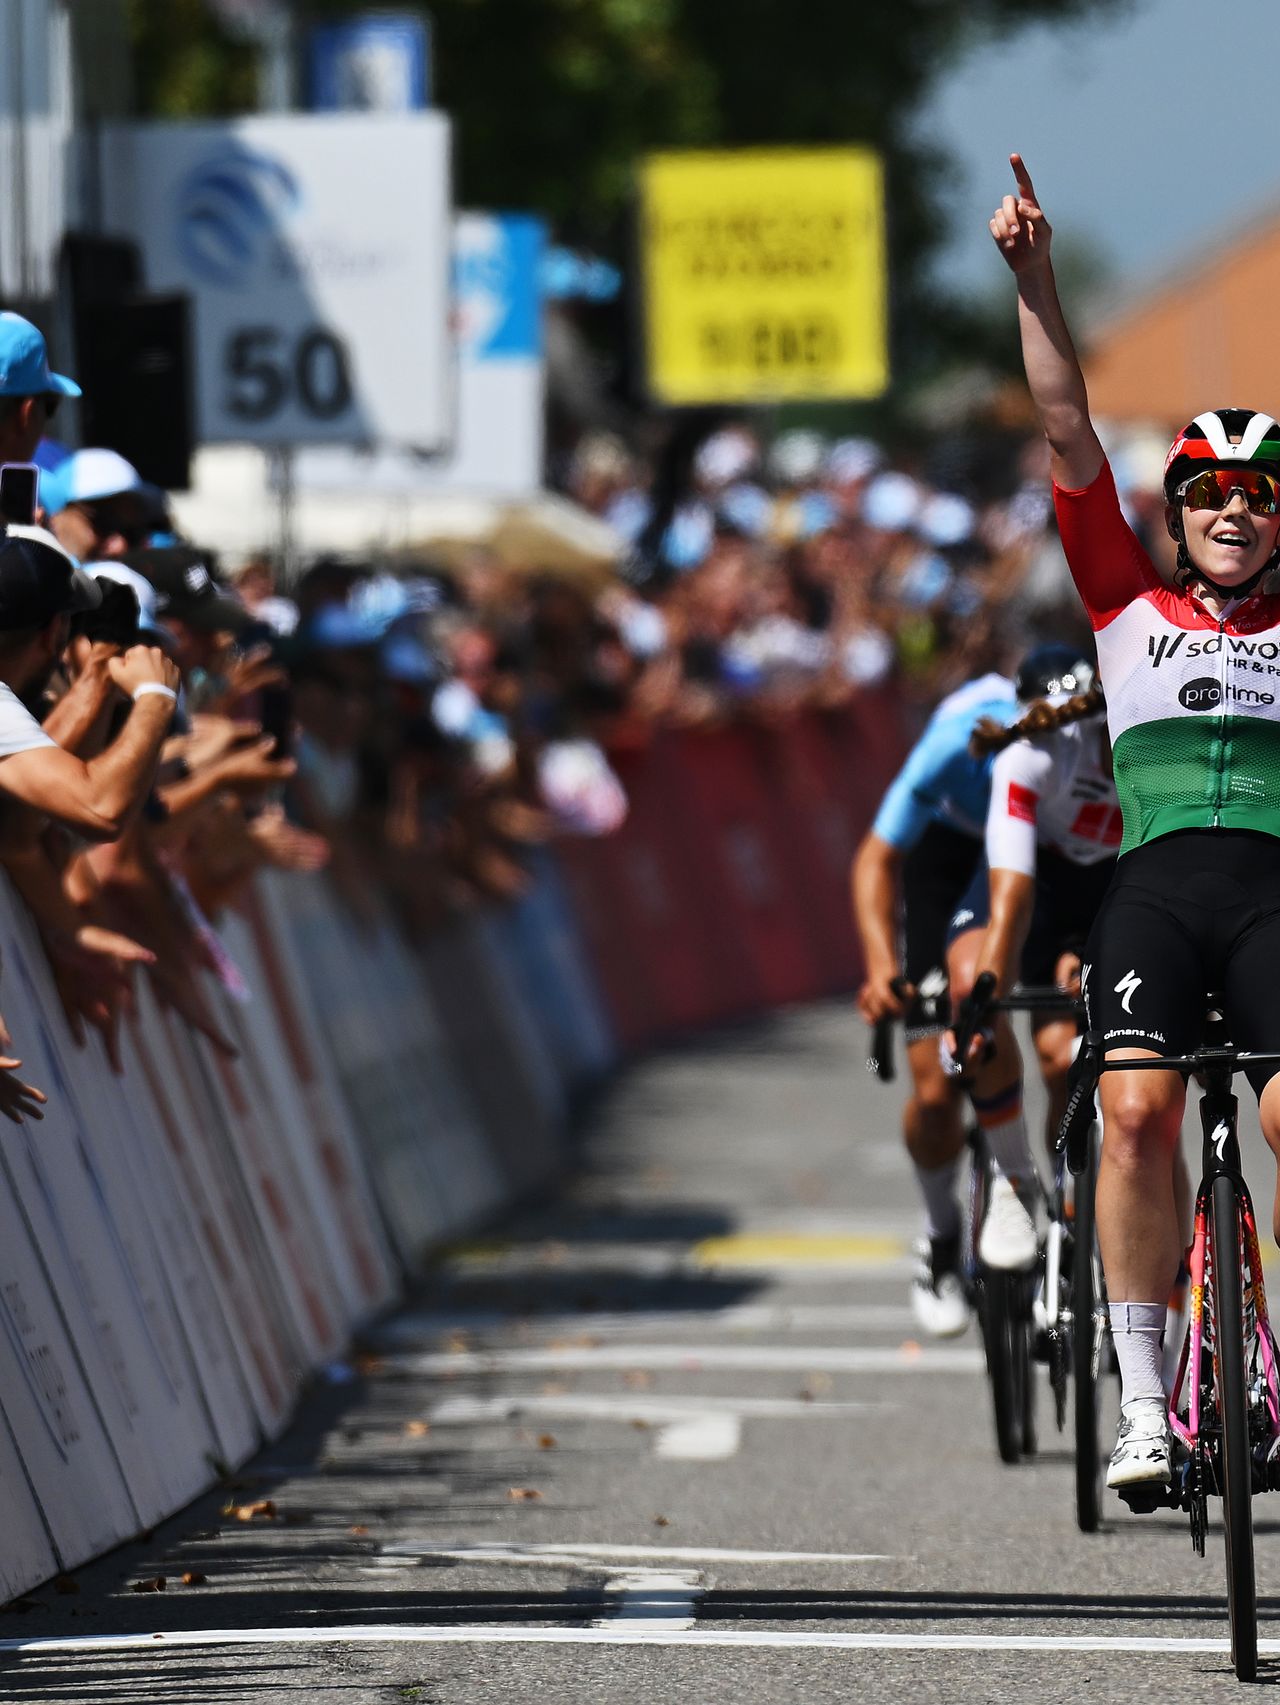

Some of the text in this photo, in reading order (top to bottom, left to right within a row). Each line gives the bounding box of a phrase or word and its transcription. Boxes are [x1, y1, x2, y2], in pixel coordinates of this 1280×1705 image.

[225, 324, 354, 421] 50
[1227, 656, 1248, 670] HR
[1252, 661, 1264, 673] &
[1103, 1029, 1146, 1040] olmans
